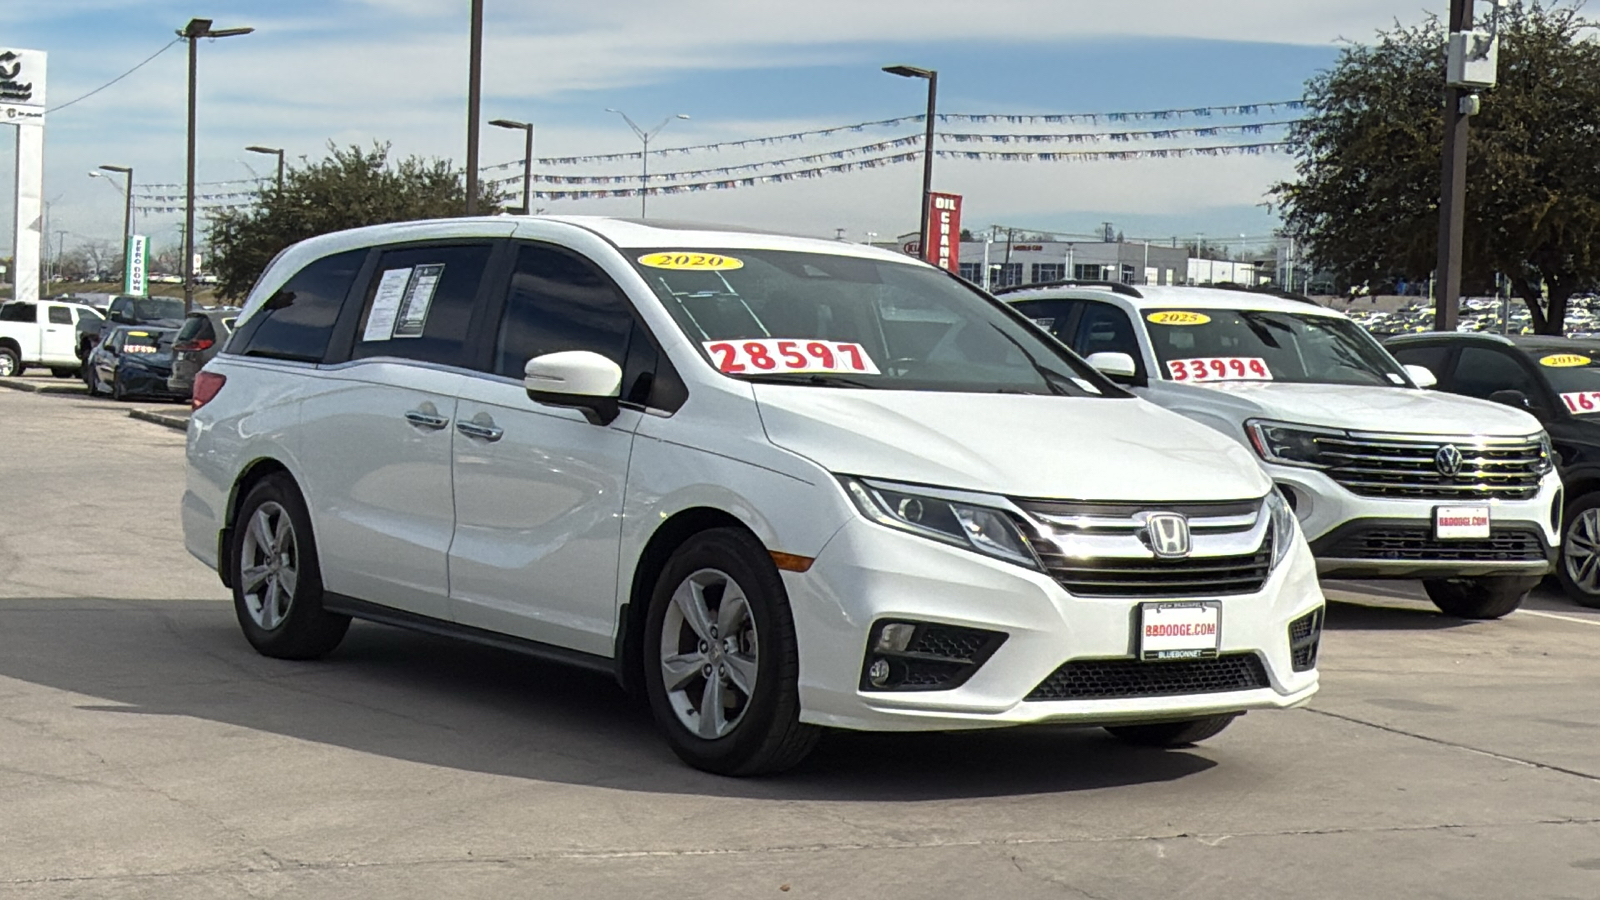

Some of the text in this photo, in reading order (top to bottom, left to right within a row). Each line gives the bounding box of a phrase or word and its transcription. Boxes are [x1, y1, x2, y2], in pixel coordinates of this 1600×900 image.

[936, 197, 956, 210] OIL
[939, 212, 950, 270] CHANG
[658, 255, 723, 266] 2020
[133, 266, 141, 291] DOWN
[1159, 313, 1198, 322] 2025
[710, 342, 865, 373] 28597
[1551, 356, 1582, 365] 2018
[1145, 623, 1216, 637] BBDODGE.COM
[1158, 650, 1202, 659] BLUEBONNET
